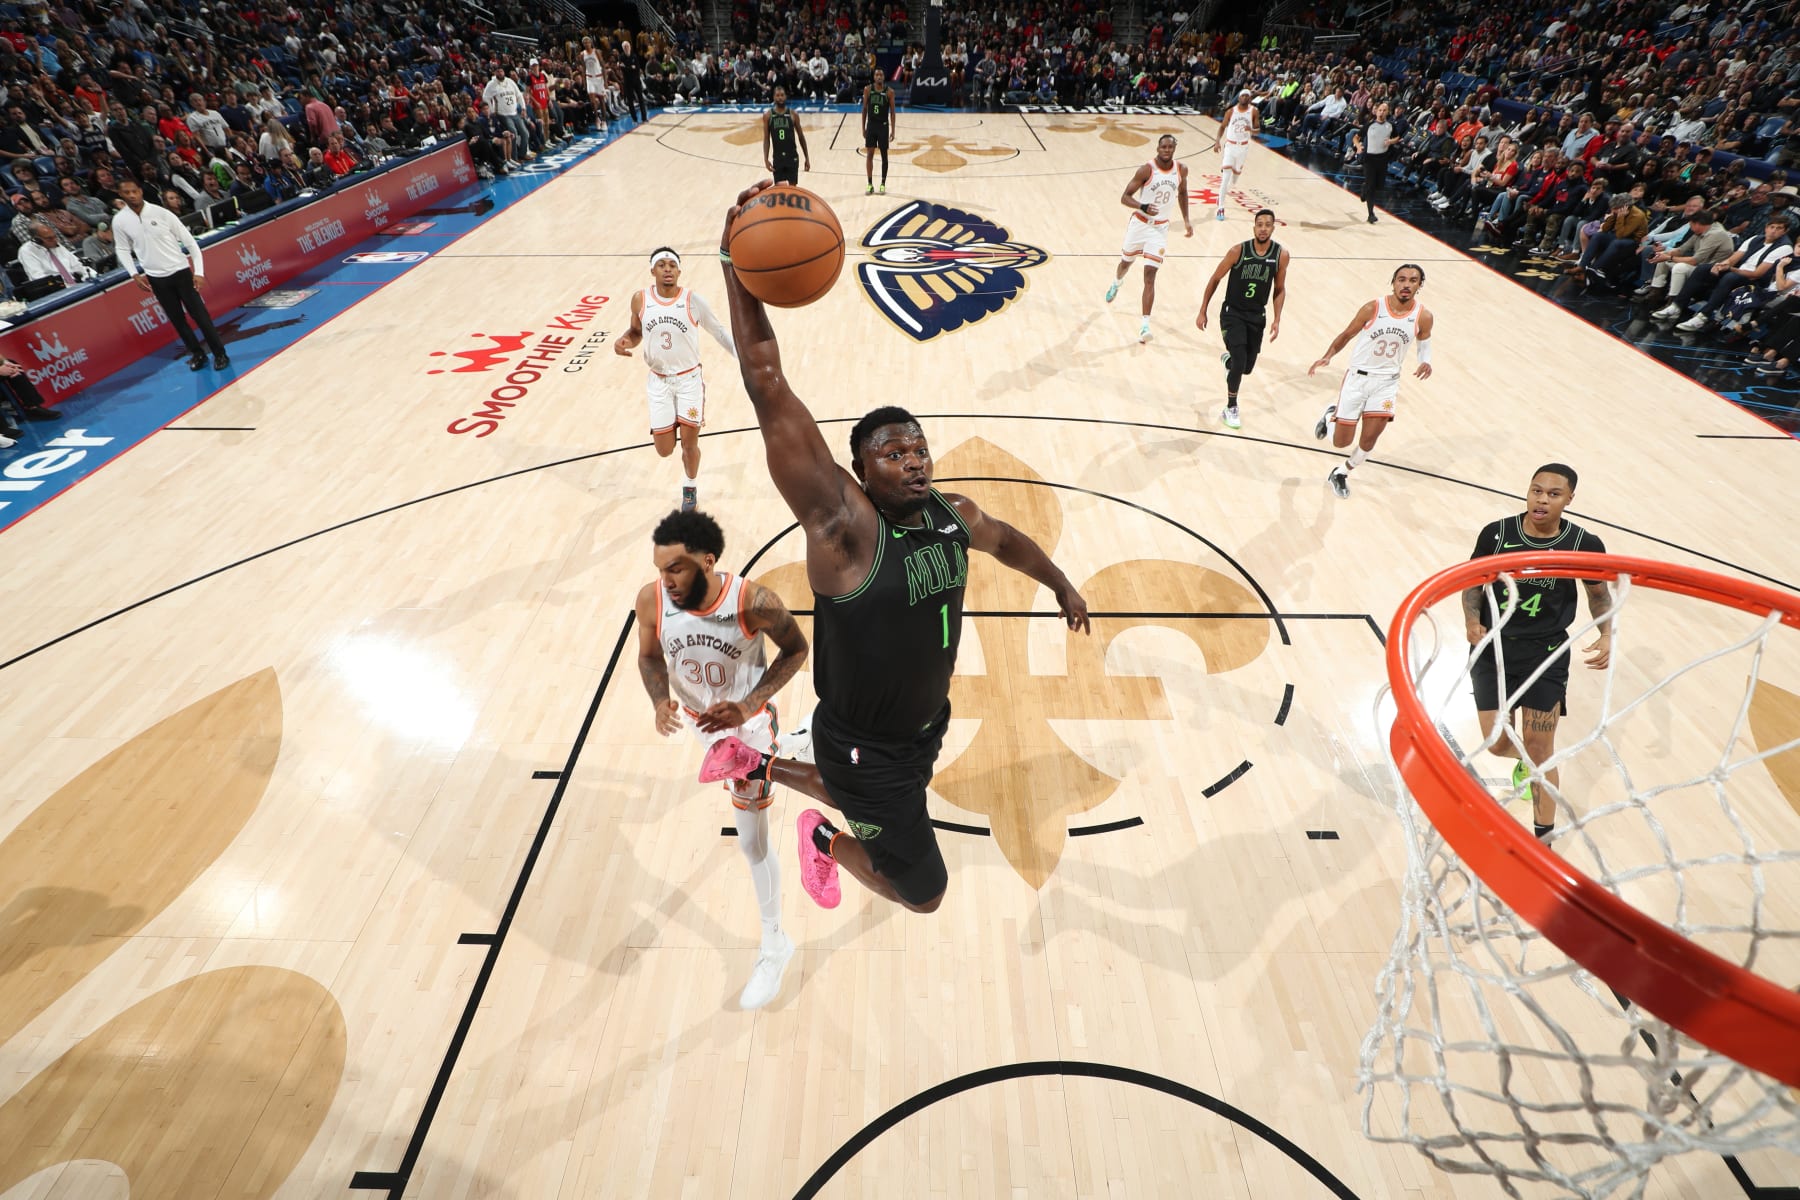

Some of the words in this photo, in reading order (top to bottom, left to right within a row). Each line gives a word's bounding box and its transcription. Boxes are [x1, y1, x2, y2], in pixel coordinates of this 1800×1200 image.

[873, 104, 880, 114] 5
[1018, 104, 1201, 115] PELICANS
[778, 129, 785, 140] 8
[1154, 190, 1171, 205] 28
[296, 233, 316, 254] THE
[312, 219, 346, 247] BLENDER
[235, 258, 273, 284] SMOOTHIE
[1240, 263, 1270, 283] NOLA
[1245, 282, 1257, 298] 3
[127, 308, 159, 336] THE
[646, 319, 658, 333] SAN
[658, 315, 688, 334] ANTONIO
[563, 331, 612, 373] CENTER
[660, 331, 673, 350] 3
[1373, 339, 1400, 359] 33
[26, 347, 89, 386] SMOOTHIE
[447, 334, 576, 438] SMOOTHIE
[904, 541, 968, 607] NOLA
[940, 603, 950, 649] 1
[668, 637, 685, 659] SAN
[686, 633, 742, 660] ANTONIO
[681, 658, 727, 688] 30
